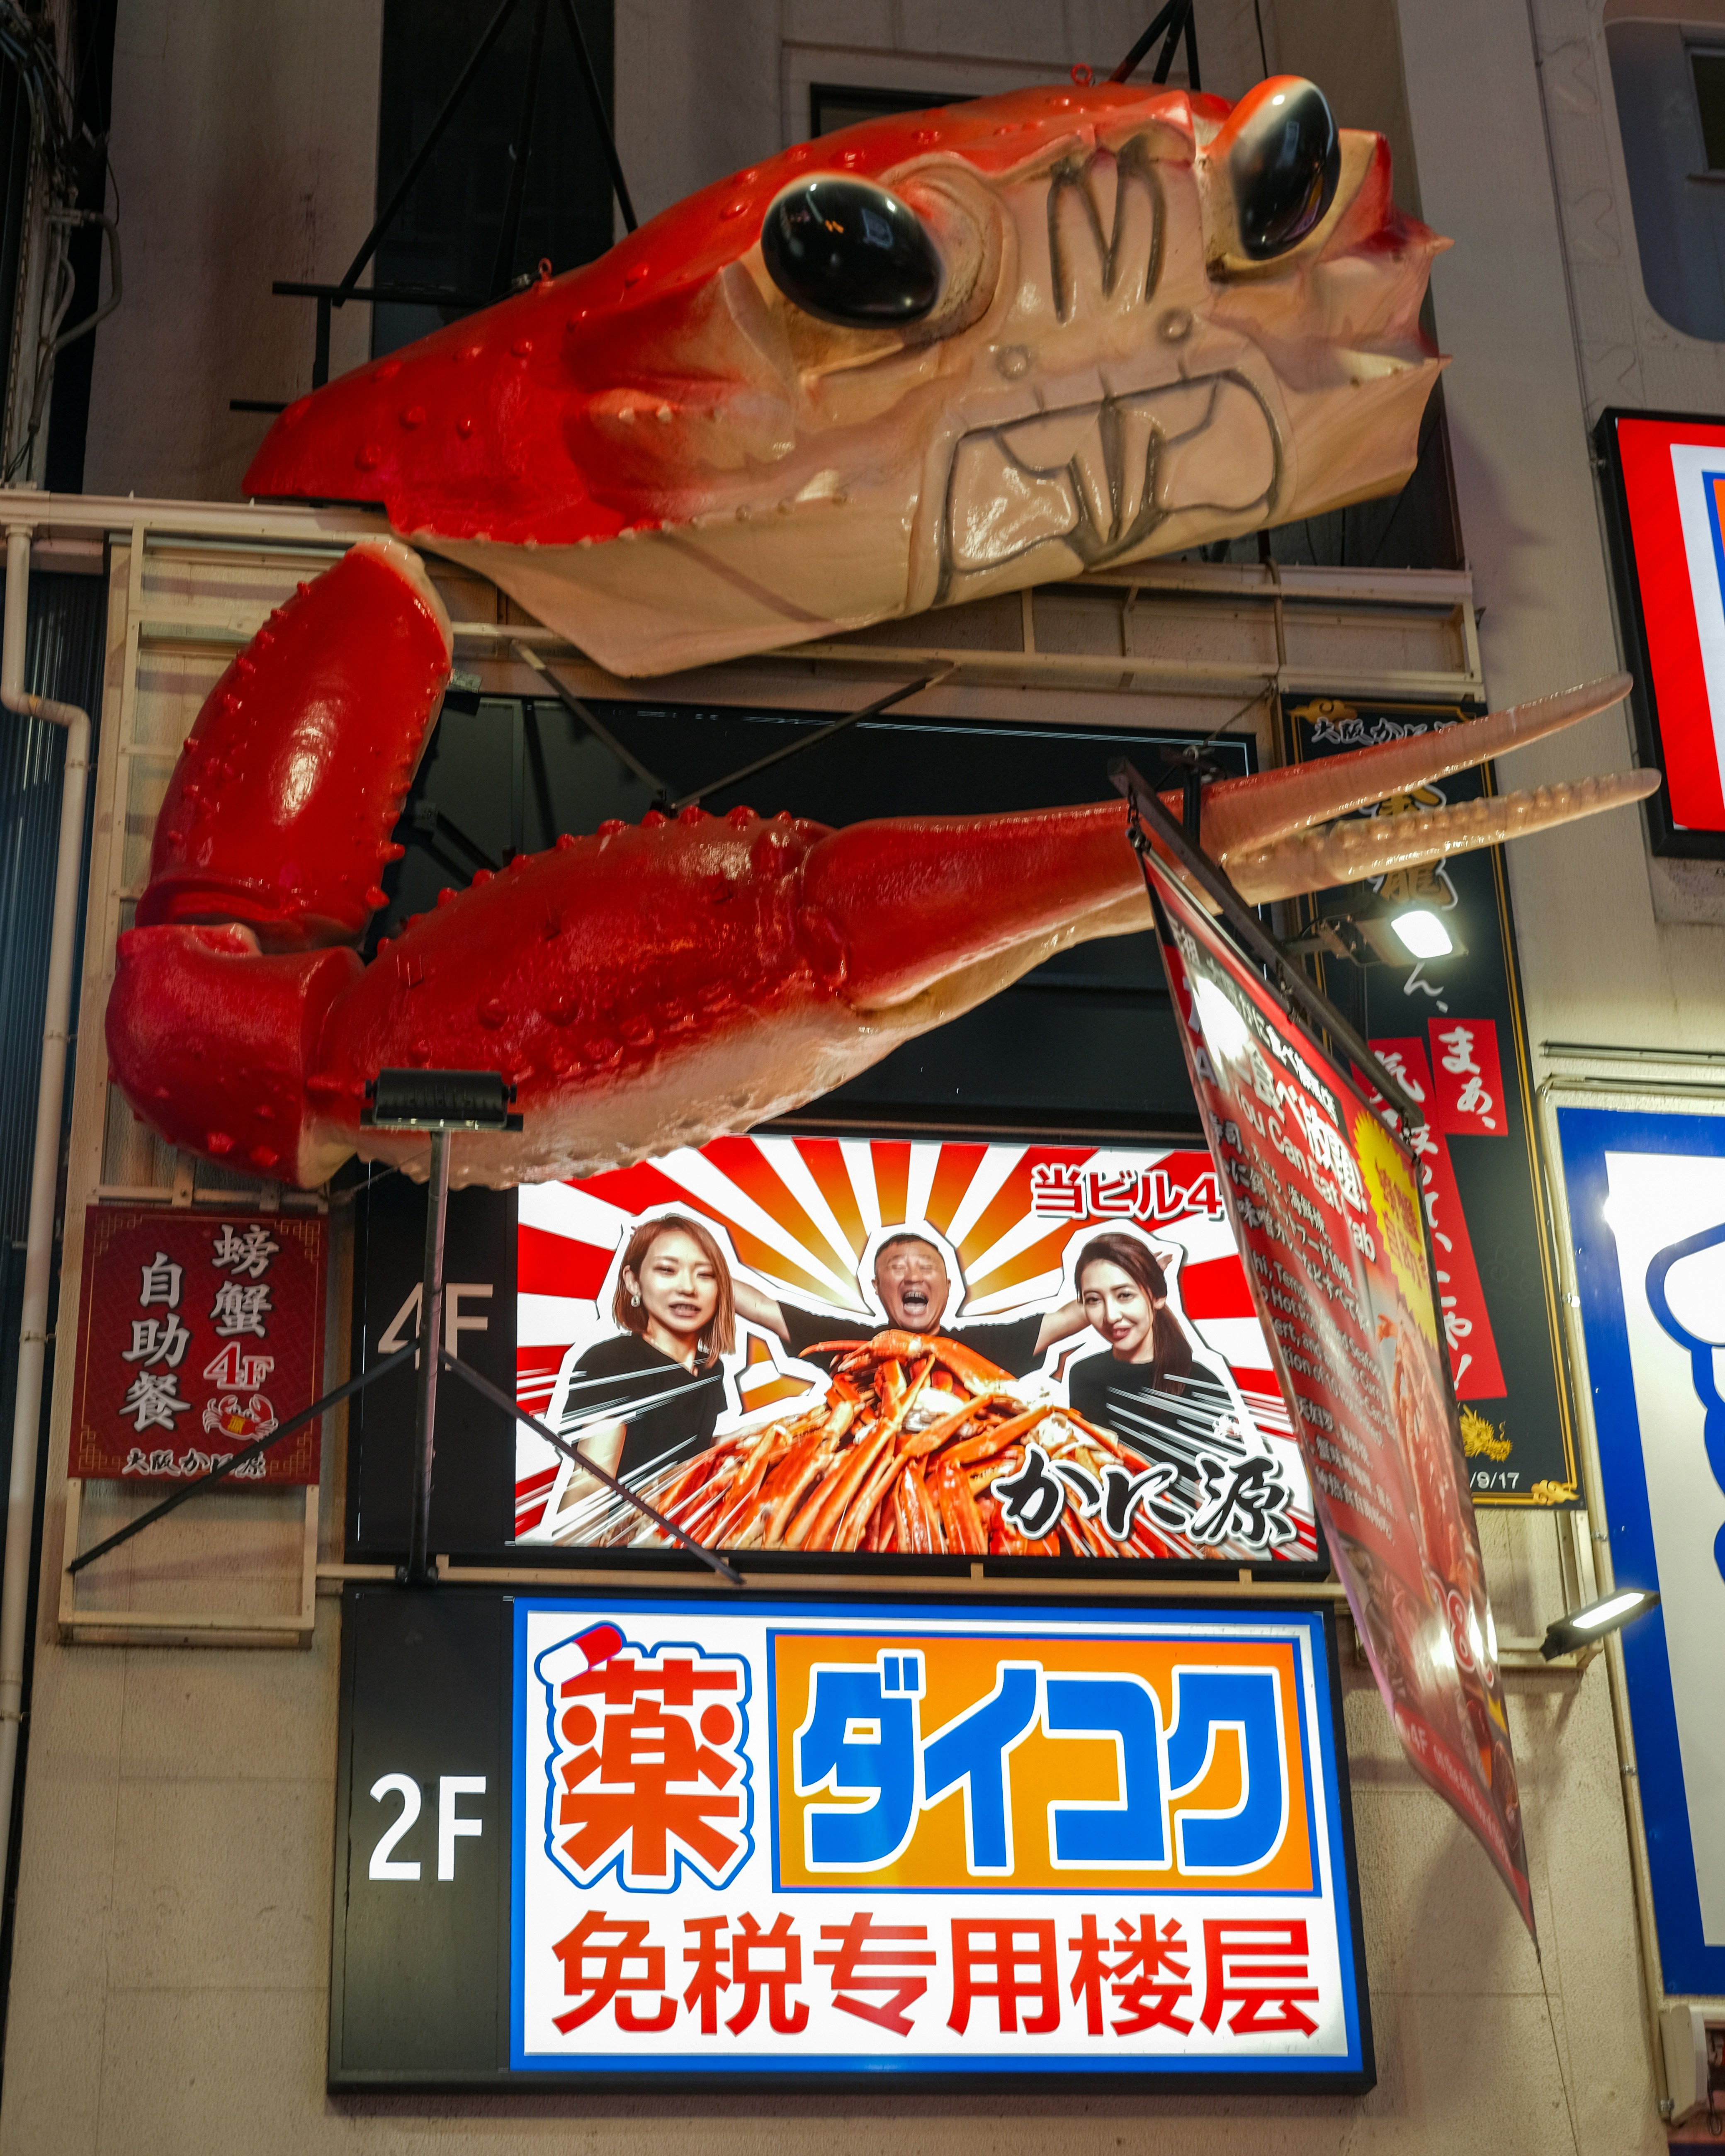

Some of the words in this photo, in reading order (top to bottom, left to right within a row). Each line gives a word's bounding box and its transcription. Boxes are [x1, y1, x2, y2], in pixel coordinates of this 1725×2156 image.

[1268, 1115, 1309, 1179] Can
[1308, 1156, 1343, 1215] Eat
[210, 1224, 279, 1338] 螃蟹
[1252, 1250, 1272, 1282] hi,
[119, 1252, 191, 1432] 自助餐
[203, 1341, 274, 1390] 4F
[378, 1282, 493, 1371] 4F
[994, 1445, 1294, 1547] かに源
[549, 1640, 748, 1886] 薬
[794, 1649, 1290, 1876] ダイコク
[369, 1772, 487, 1881] 2F
[552, 1909, 1319, 2039] 免税专用楼层
